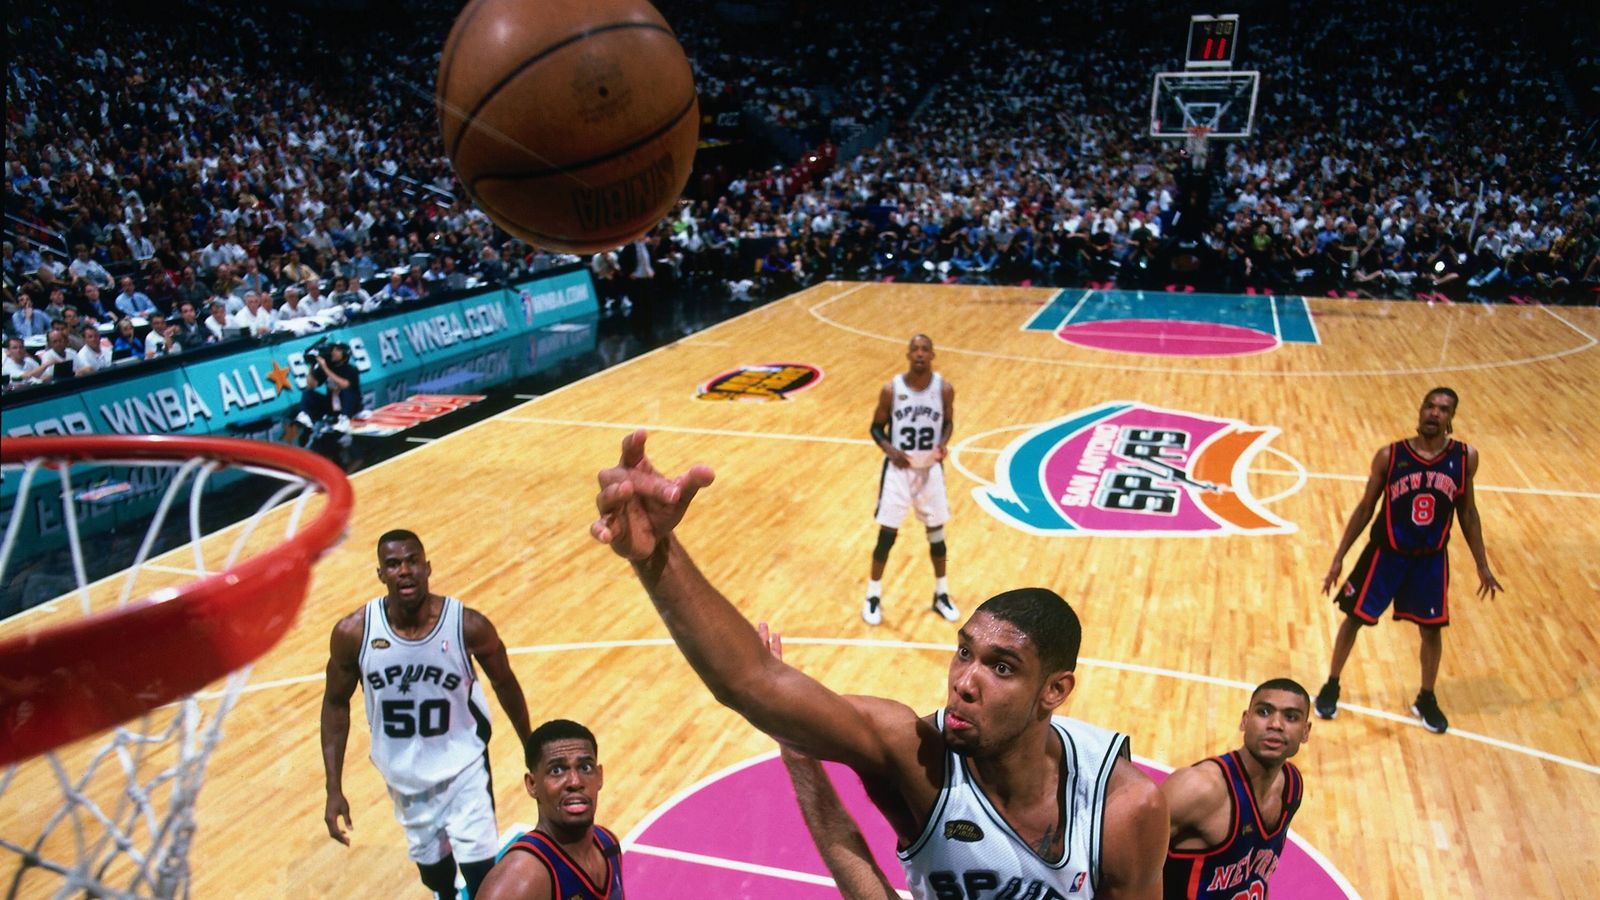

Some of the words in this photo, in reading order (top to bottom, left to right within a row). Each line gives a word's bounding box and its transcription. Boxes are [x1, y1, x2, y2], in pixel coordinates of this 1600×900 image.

[1203, 38, 1227, 60] 11
[377, 326, 404, 366] AT
[404, 301, 508, 356] WNBA.COM
[100, 382, 212, 435] WNBA
[218, 364, 276, 414] ALL
[895, 405, 940, 422] SPURS
[900, 427, 935, 451] 32
[1076, 424, 1120, 475] ANTONIO
[1092, 425, 1192, 516] SPURS
[1390, 471, 1423, 502] NEW
[1426, 471, 1458, 503] YORK
[1060, 474, 1099, 507] SAN
[1411, 493, 1436, 526] 8
[367, 664, 462, 694] SPURS
[382, 698, 451, 739] 50
